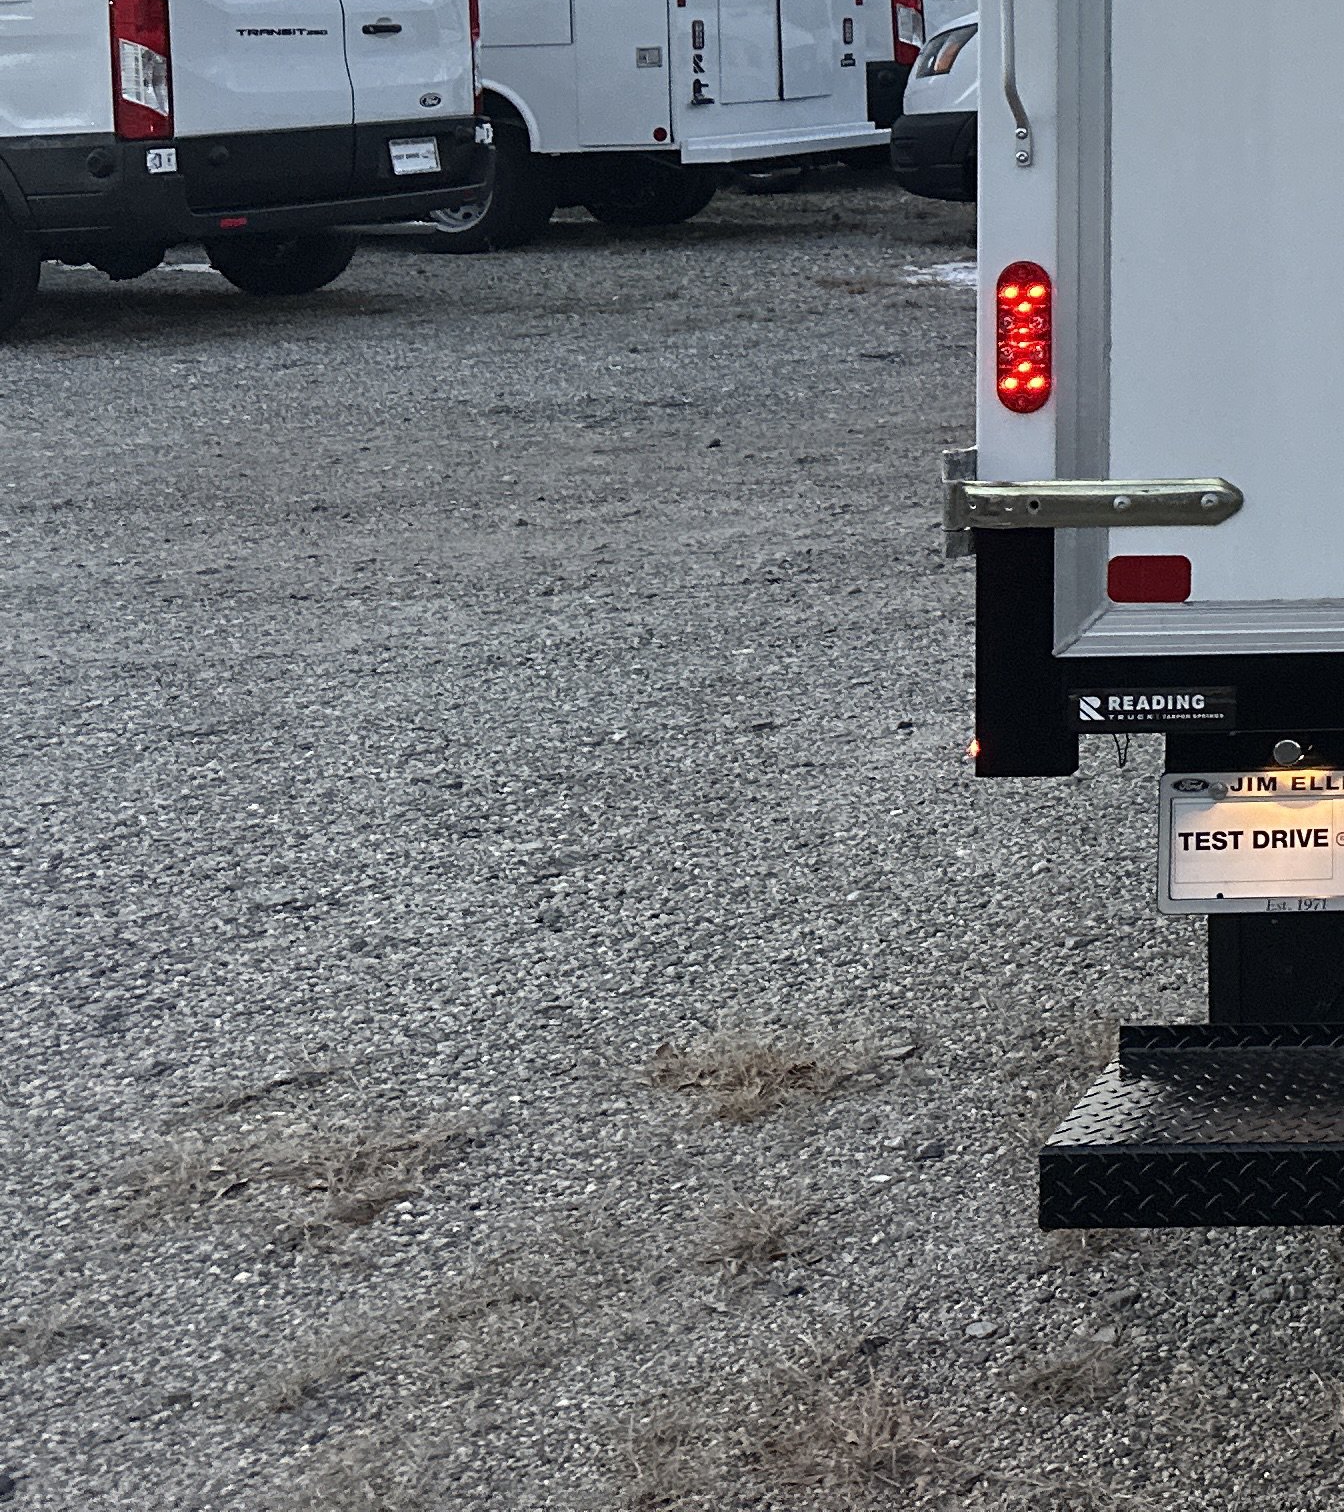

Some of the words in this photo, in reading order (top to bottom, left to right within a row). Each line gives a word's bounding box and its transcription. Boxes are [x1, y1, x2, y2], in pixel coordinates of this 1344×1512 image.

[236, 28, 306, 36] TRANSIT
[1108, 695, 1205, 711] READING
[1230, 776, 1277, 792] JIM
[1178, 830, 1244, 852] TEST
[1253, 828, 1329, 849] DRIVE
[1265, 898, 1293, 912] Est.
[1297, 897, 1327, 911] 1971
